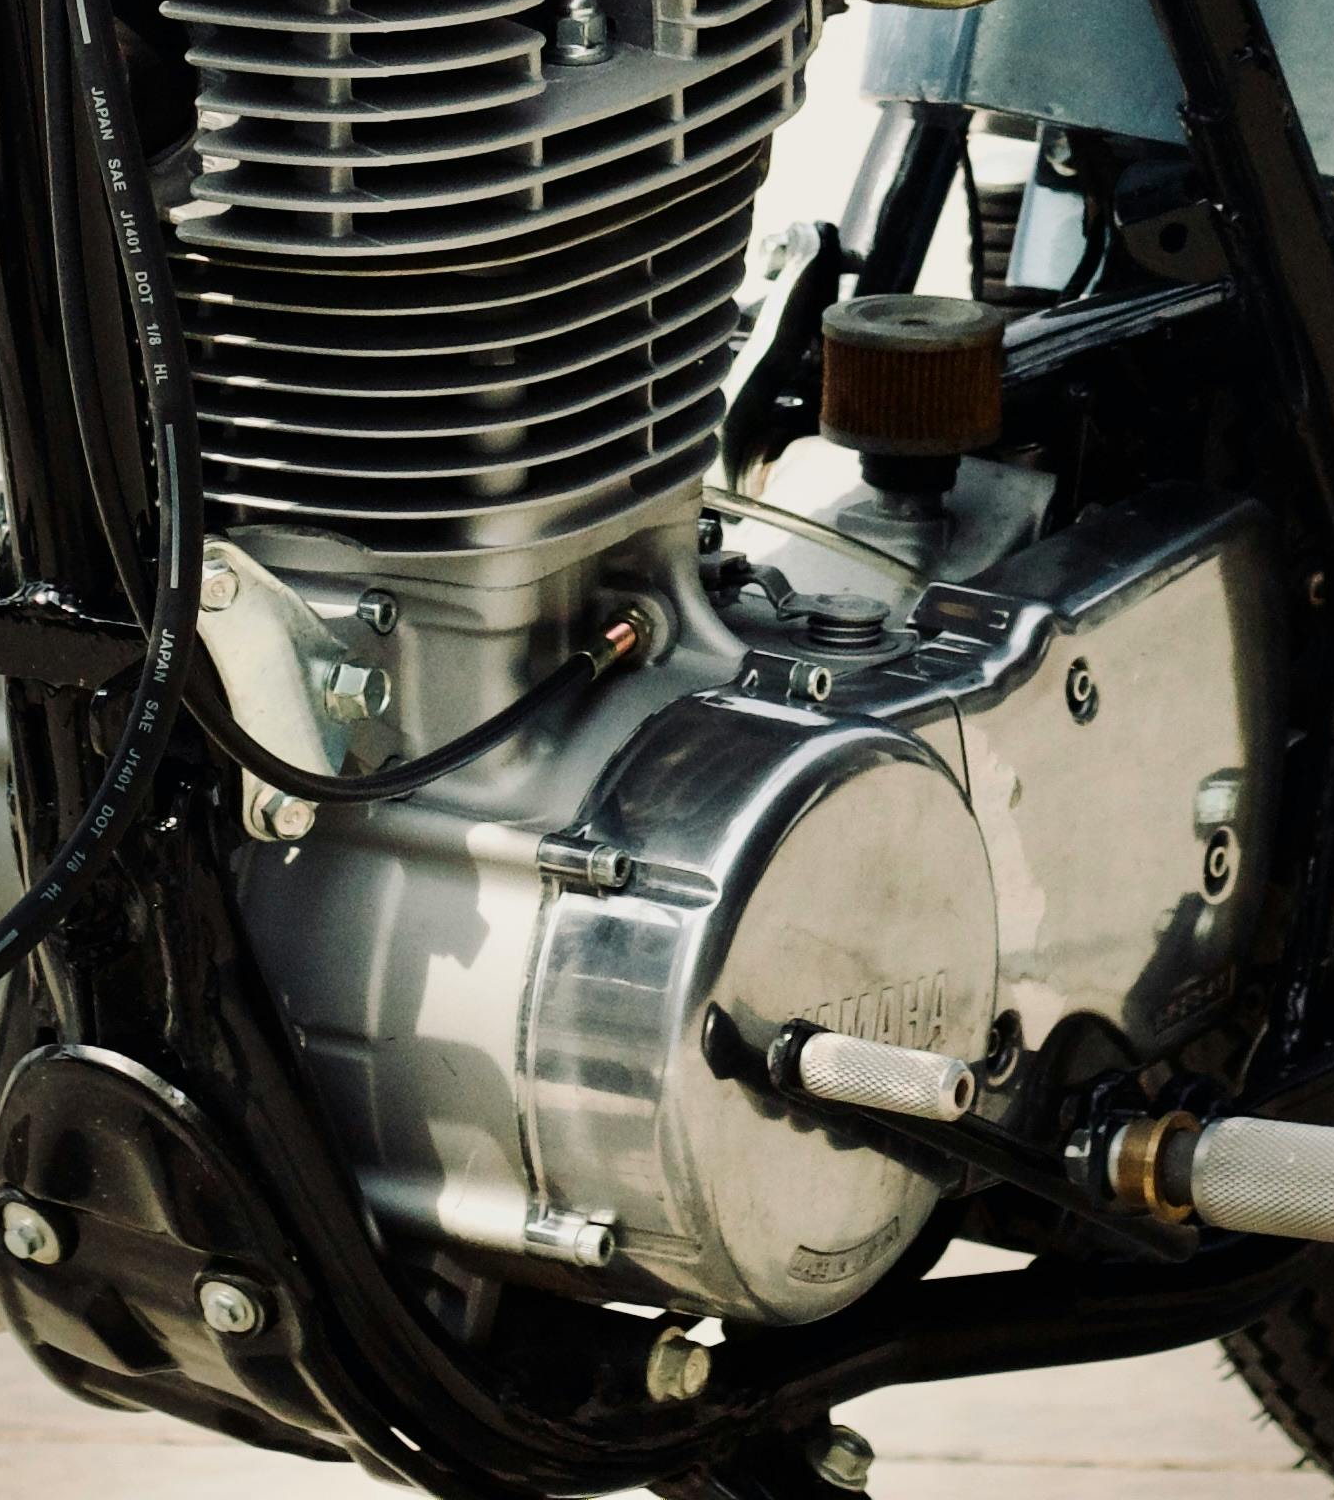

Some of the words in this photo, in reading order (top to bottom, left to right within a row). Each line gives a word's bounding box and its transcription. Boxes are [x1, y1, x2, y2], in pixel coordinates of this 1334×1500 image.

[90, 86, 115, 142] JAPAN
[107, 157, 127, 193] SAE
[119, 209, 142, 255] J1401
[134, 270, 154, 306] DOT
[146, 321, 162, 347] 1/8
[153, 362, 169, 385] HL
[153, 627, 176, 684] JAPAN
[138, 699, 159, 735] SAE
[113, 747, 142, 794] J1401
[90, 803, 116, 840] DOT
[66, 849, 87, 873] 1/8
[40, 882, 62, 902] HL
